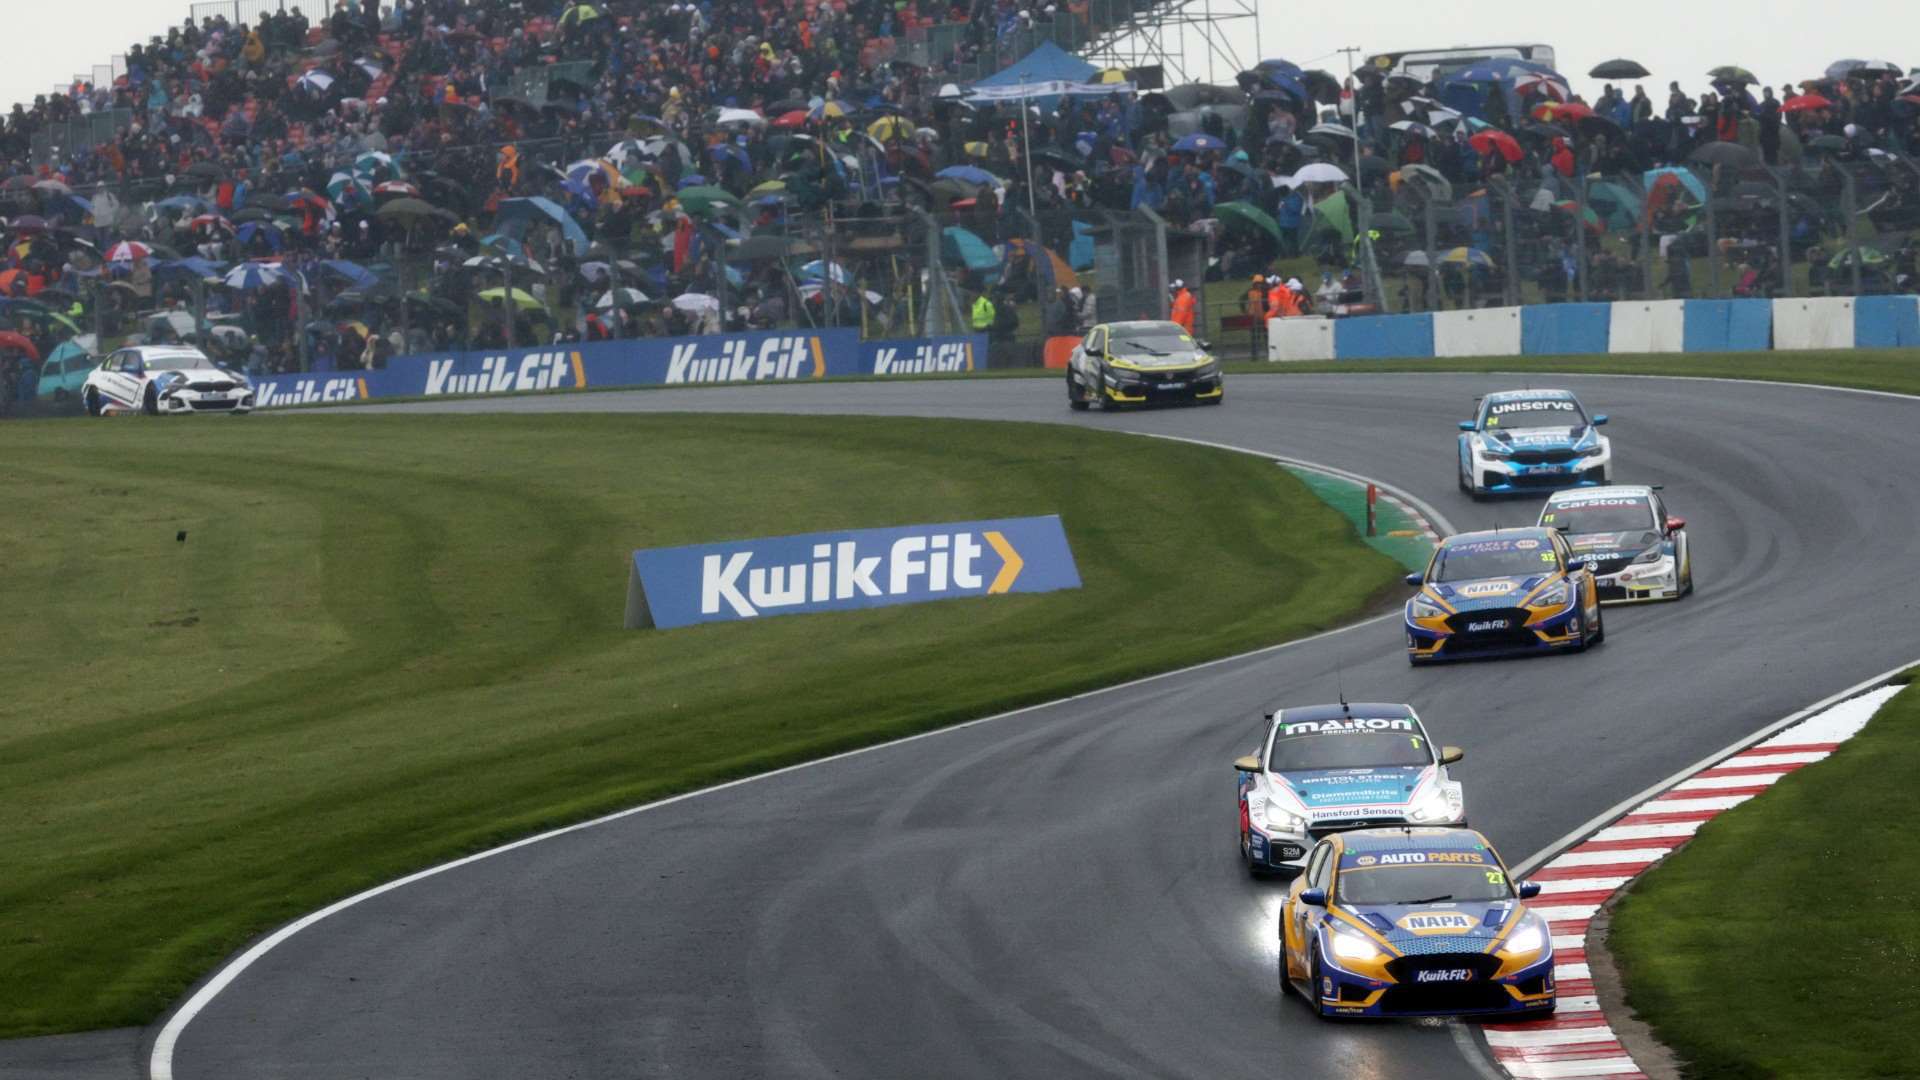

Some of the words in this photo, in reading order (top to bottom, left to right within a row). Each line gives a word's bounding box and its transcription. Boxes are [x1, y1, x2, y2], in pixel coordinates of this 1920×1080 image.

[1557, 498, 1637, 509] CarStore
[1541, 552, 1555, 562] 32
[1467, 583, 1509, 593] NAPA
[1312, 809, 1360, 819] Hansford
[1380, 852, 1426, 864] AUTO
[1428, 852, 1484, 863] PARTS
[1408, 916, 1468, 929] NAPA
